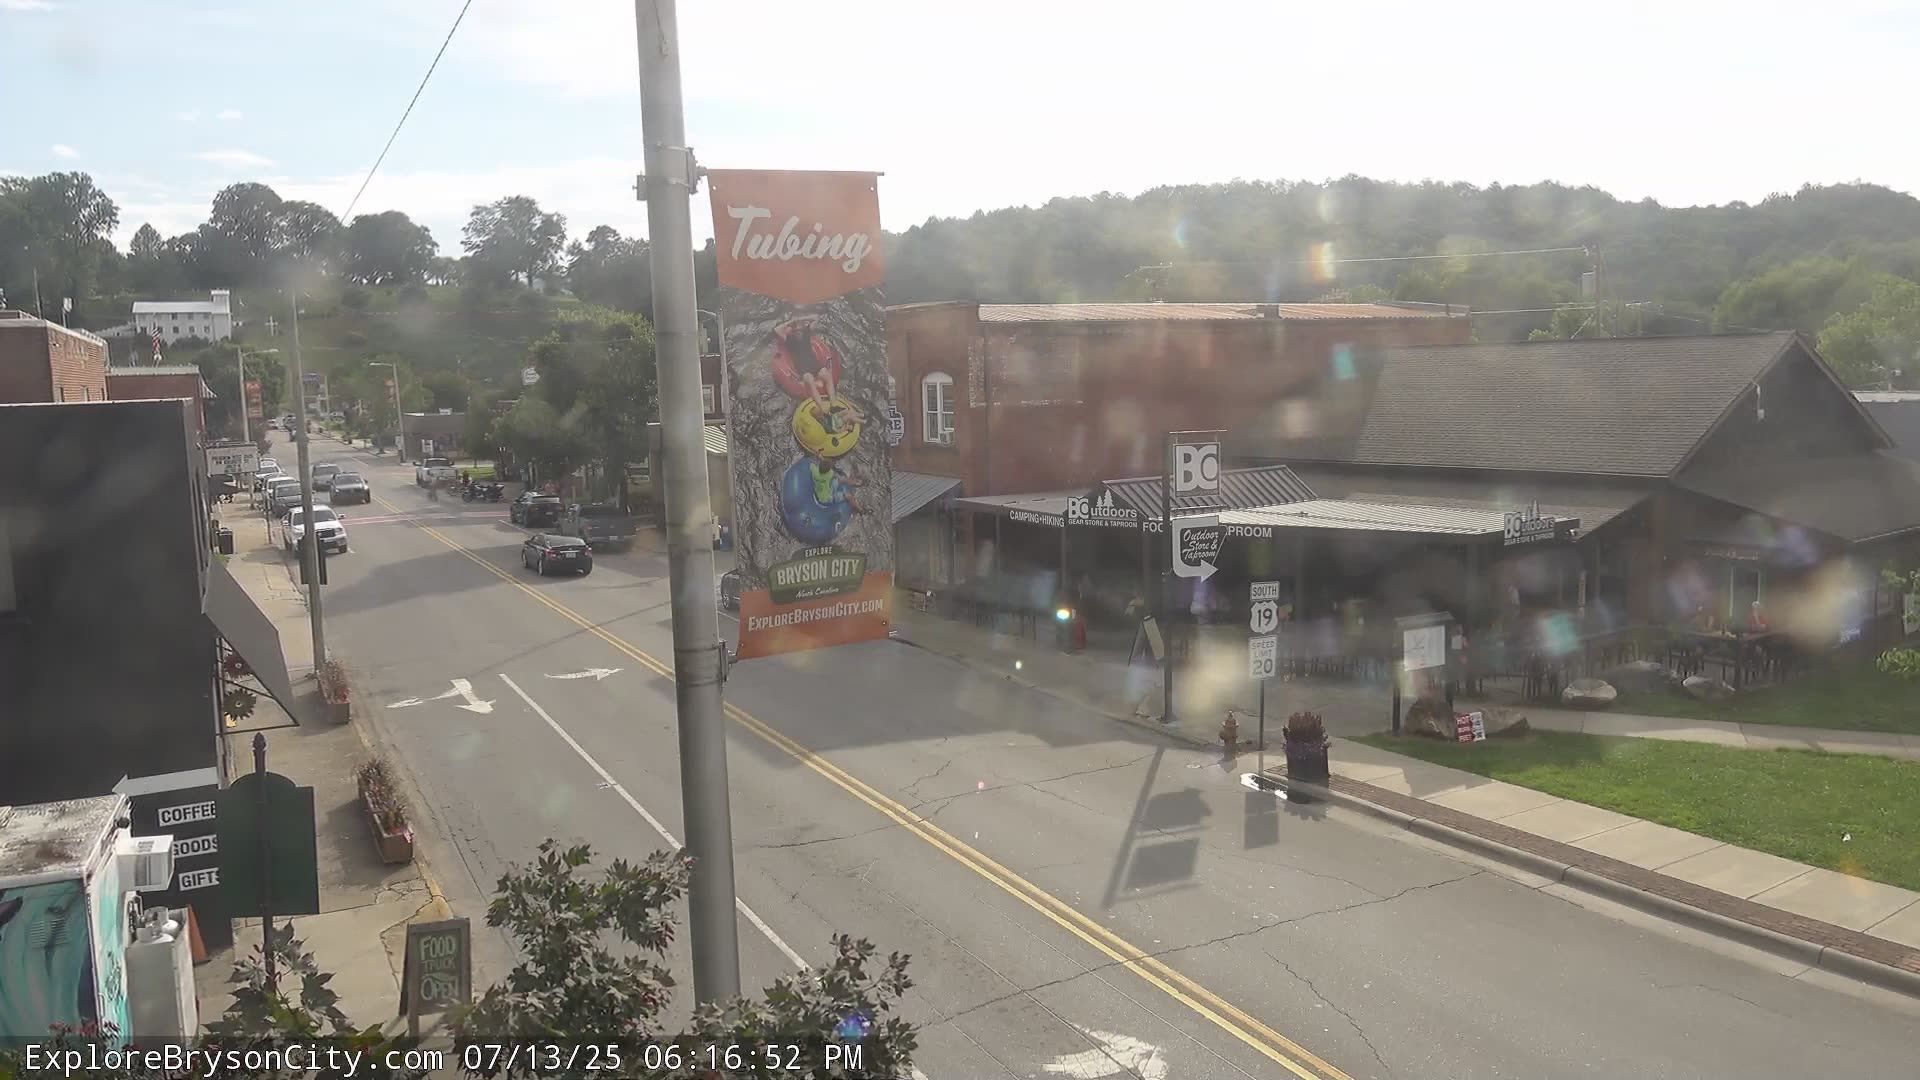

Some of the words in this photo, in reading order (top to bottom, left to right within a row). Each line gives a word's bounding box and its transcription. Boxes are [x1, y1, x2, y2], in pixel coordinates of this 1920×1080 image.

[727, 205, 872, 273] Tubing
[1183, 529, 1219, 541] Outdoor
[805, 546, 833, 557] EXPLORE
[1188, 540, 1208, 551] Store
[1182, 549, 1216, 561] Taproom
[777, 560, 828, 585] BRYSON
[831, 559, 860, 577] CITY
[1252, 586, 1277, 597] SOUTH
[1257, 608, 1273, 628] 19
[1252, 658, 1273, 675] 20
[421, 936, 456, 960] FOOD
[421, 976, 459, 1001] OPEN
